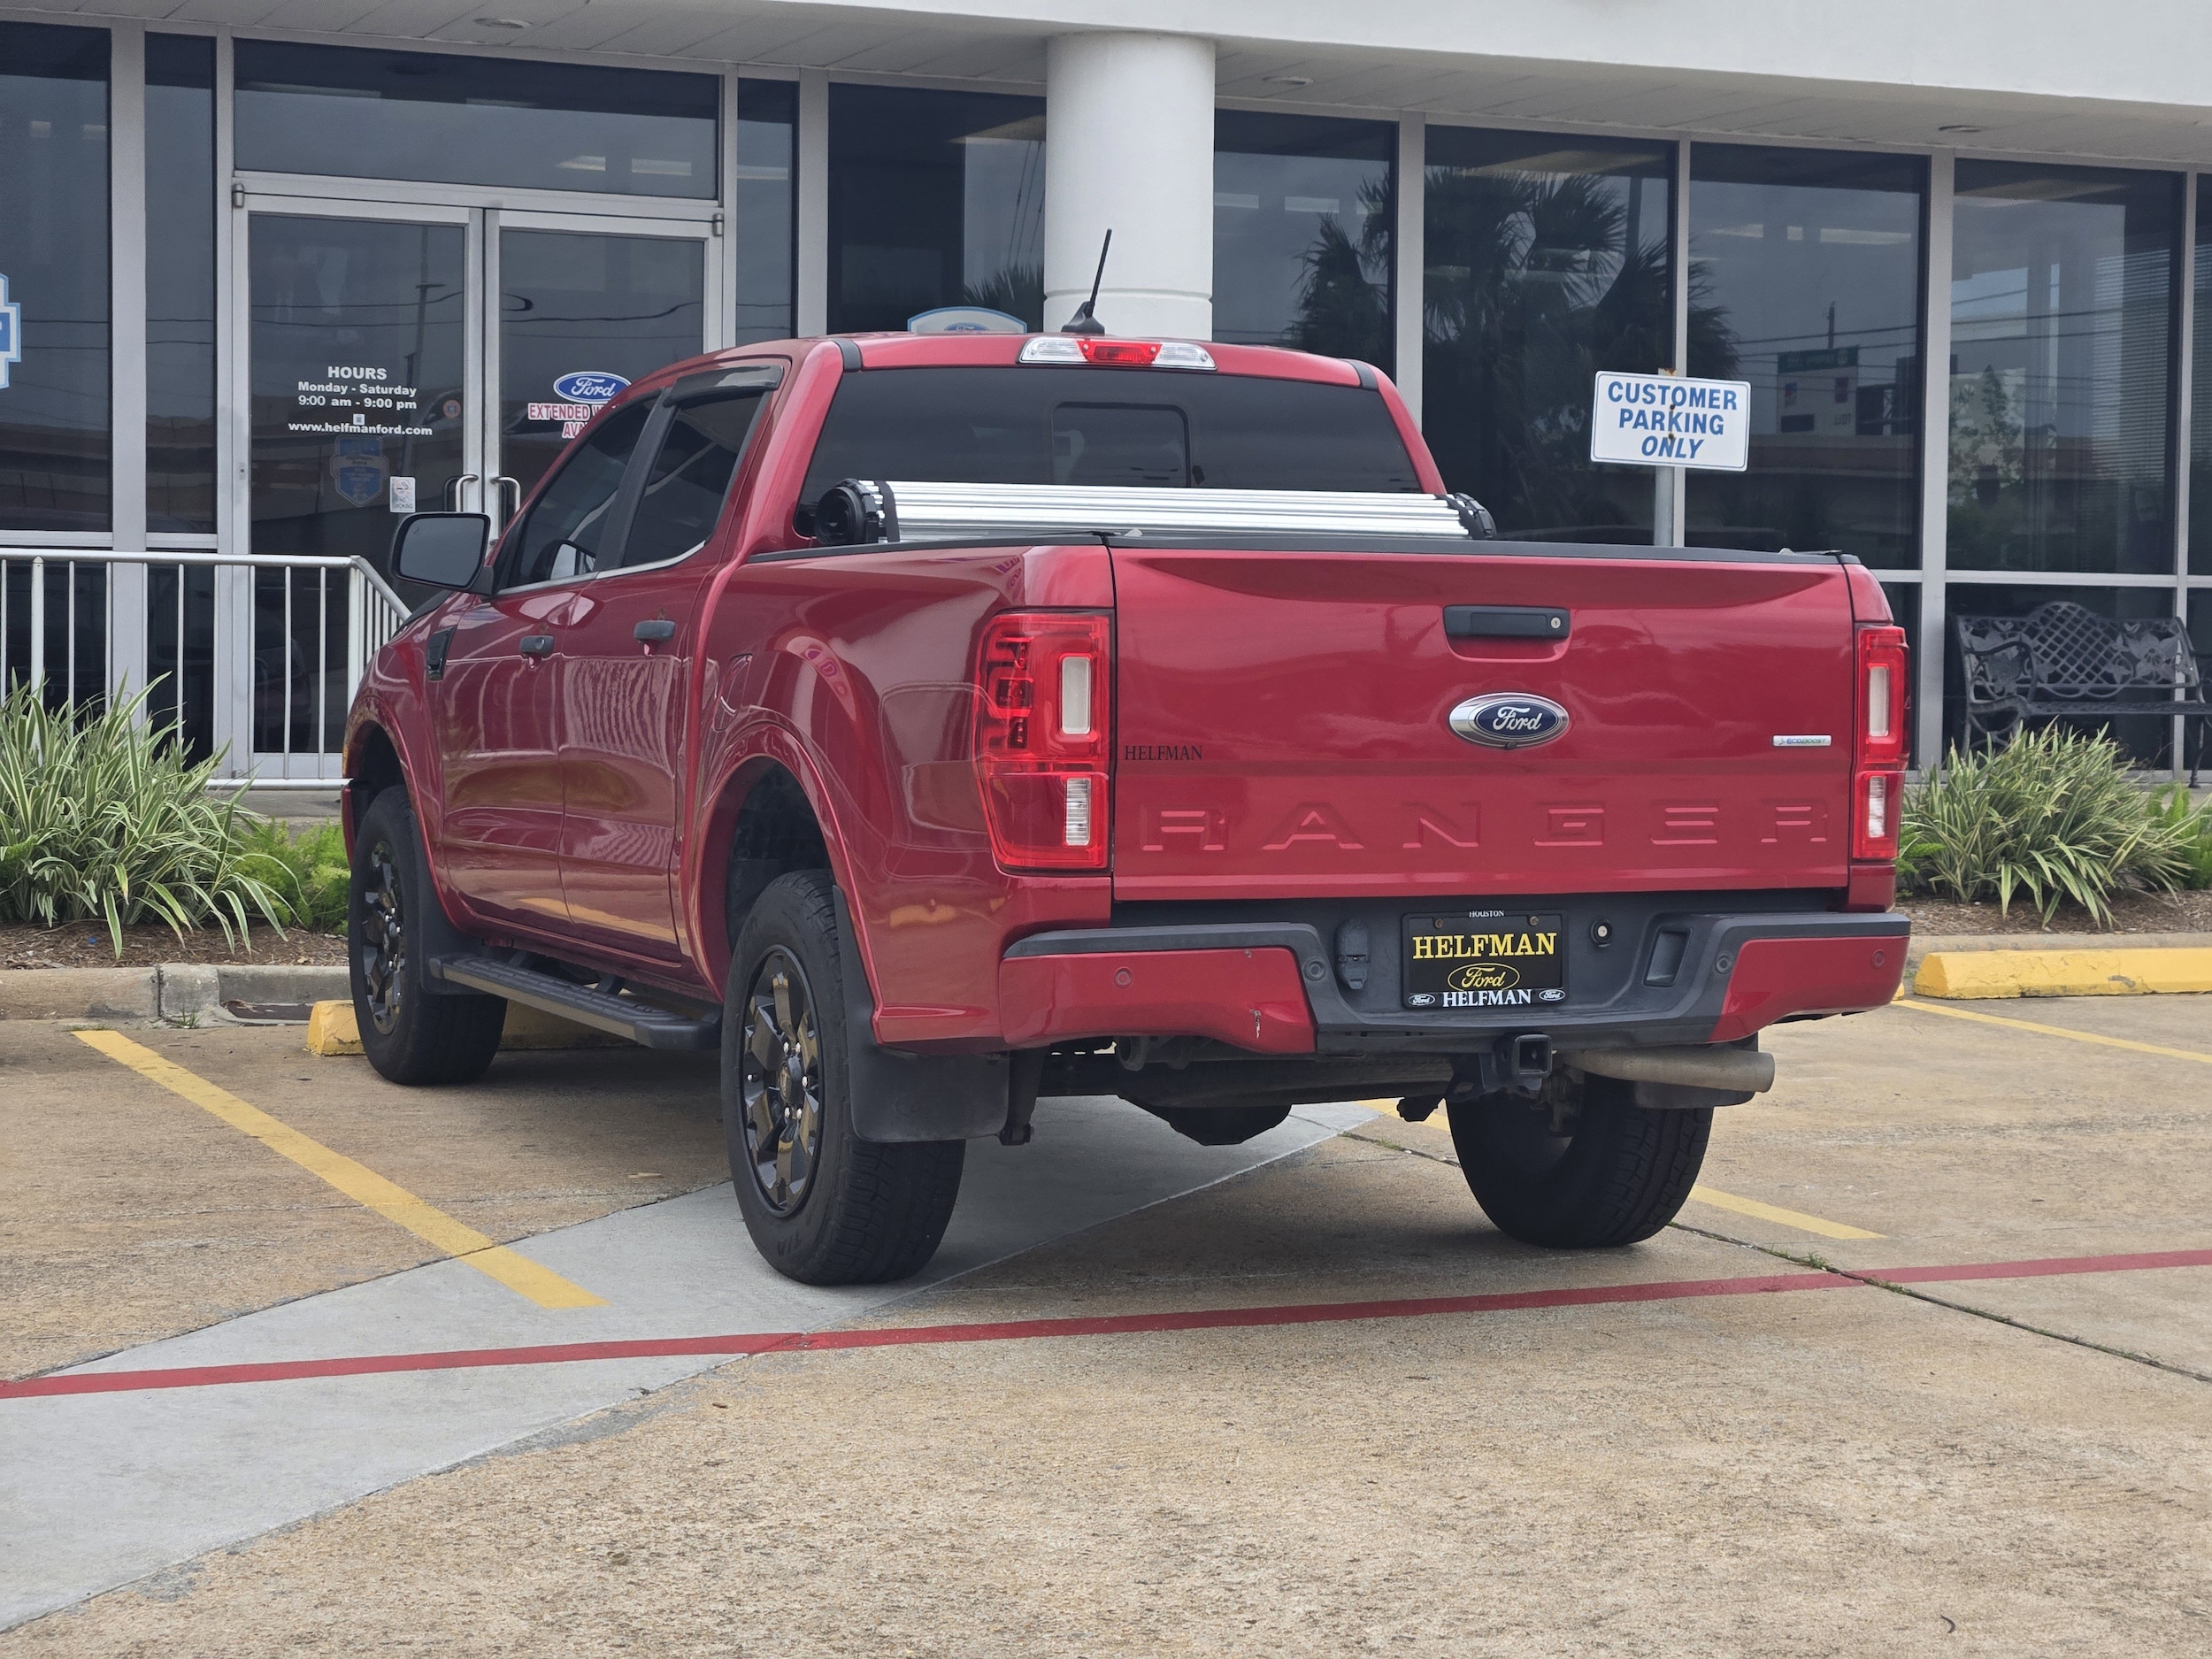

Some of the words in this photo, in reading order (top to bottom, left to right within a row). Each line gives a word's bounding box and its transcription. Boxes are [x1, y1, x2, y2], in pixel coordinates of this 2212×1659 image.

[327, 365, 388, 380] HOURS
[297, 380, 349, 395] Monday
[359, 383, 418, 397] Saturday
[571, 376, 617, 396] Ford
[1608, 380, 1738, 411] CUSTOMER
[297, 395, 326, 406] 9:00
[363, 398, 393, 409] 9:00
[396, 401, 418, 411] pm
[528, 403, 590, 419] EXTENDED
[288, 422, 433, 435] www.helfmanford.com
[1618, 408, 1724, 435] PARKING
[1640, 434, 1705, 459] ONLY
[1492, 705, 1543, 731] Ford
[1125, 745, 1203, 761] HELFMAN
[1140, 798, 1828, 852] RANGER
[1469, 910, 1505, 918] HOUSTON
[1412, 932, 1557, 960] HELFMAN
[1460, 965, 1507, 988] Ford
[1442, 988, 1532, 1008] HELFMAN
